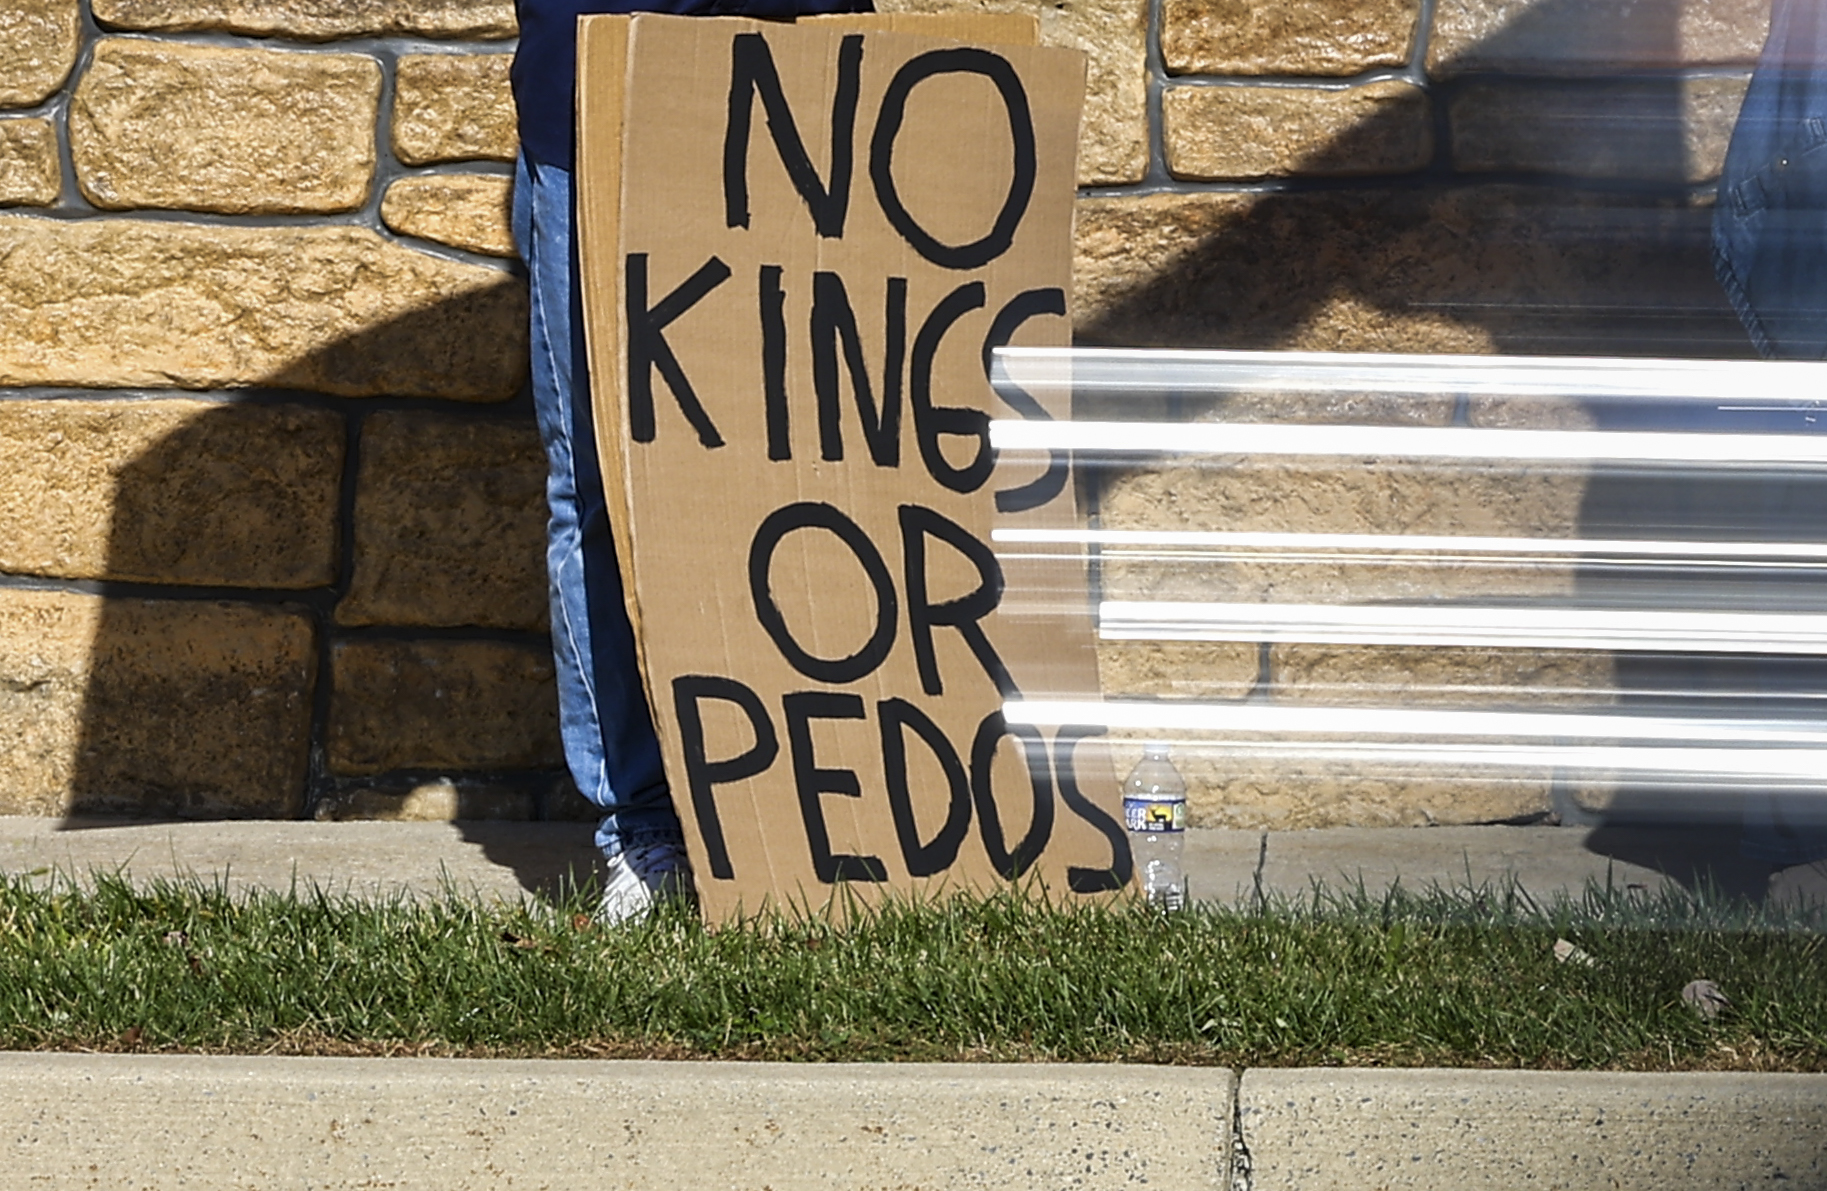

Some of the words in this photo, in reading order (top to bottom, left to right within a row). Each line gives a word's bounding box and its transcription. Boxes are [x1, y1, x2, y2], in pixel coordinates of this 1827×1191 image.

[724, 32, 1037, 270] NO
[626, 253, 1067, 512] KINGS
[749, 502, 1025, 702] OR
[672, 673, 1134, 894] PEDOS
